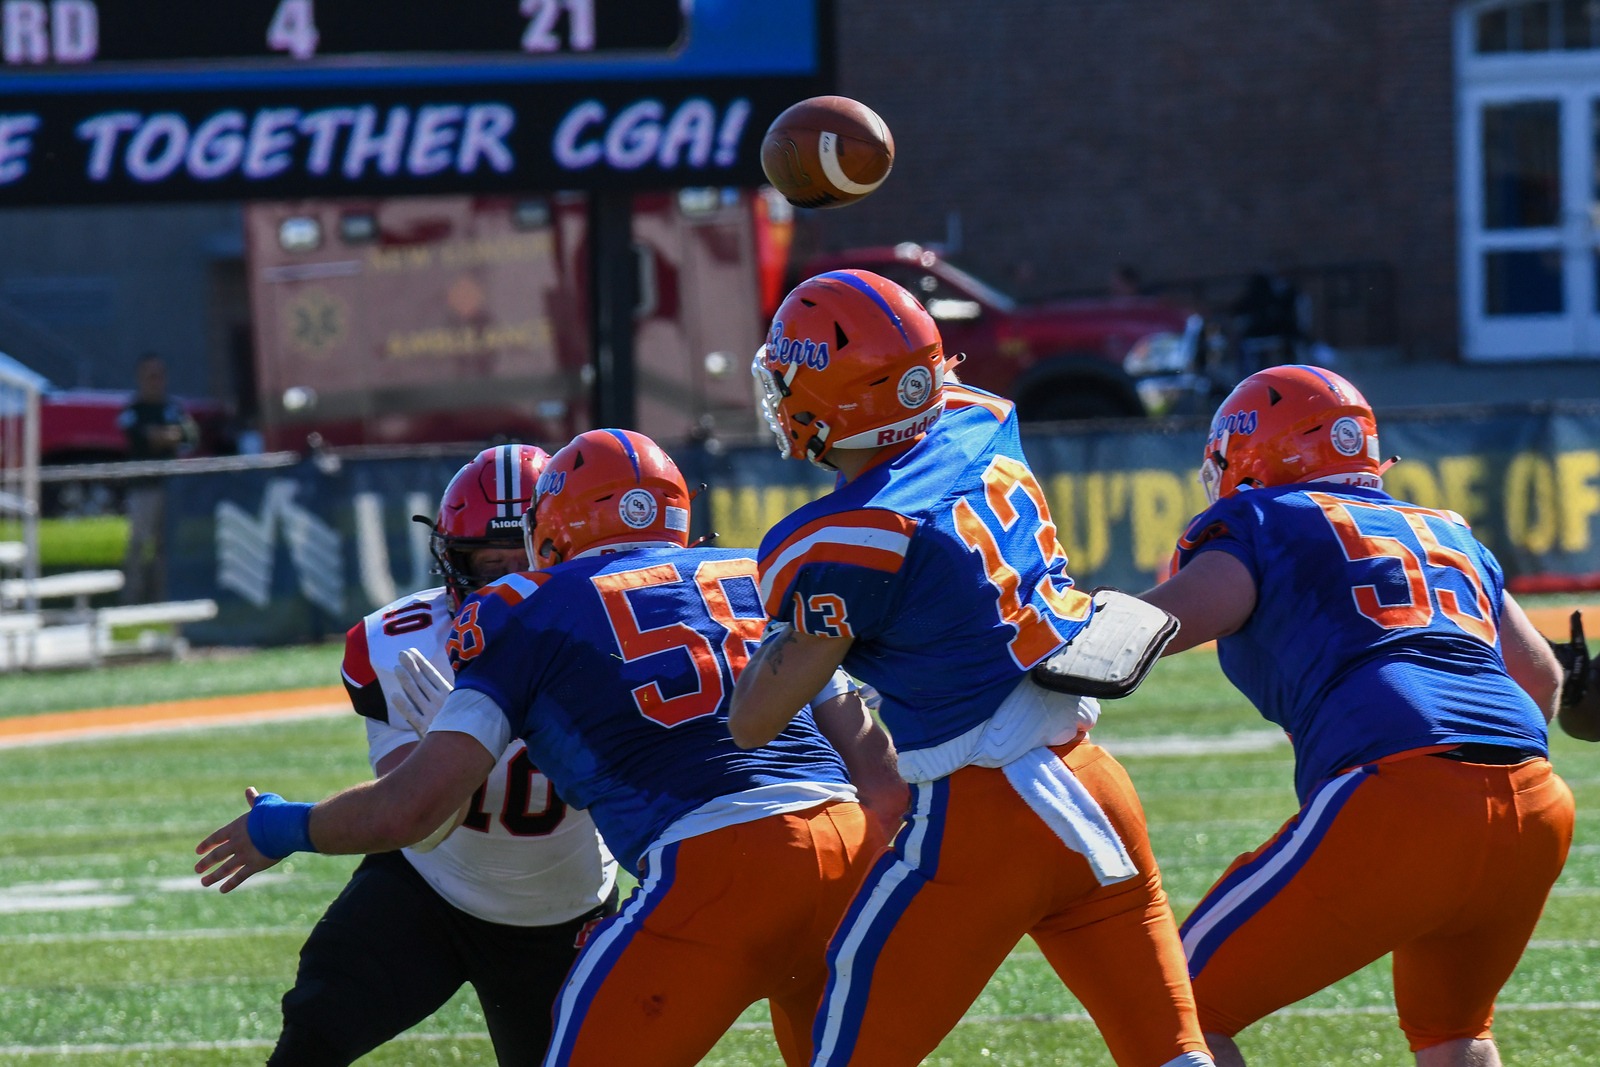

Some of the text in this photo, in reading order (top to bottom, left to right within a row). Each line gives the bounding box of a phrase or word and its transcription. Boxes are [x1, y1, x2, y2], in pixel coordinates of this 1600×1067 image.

[3, 0, 596, 64] RD 4 21
[76, 104, 515, 182] TOGETHER
[552, 98, 751, 169] CGA!
[766, 321, 830, 371] Bears
[877, 405, 943, 446] Riddel
[1208, 410, 1259, 444] ears
[1505, 450, 1600, 555] OF
[952, 454, 1095, 671] 13
[1304, 491, 1499, 649] 55
[382, 602, 433, 637] 10
[590, 558, 769, 729] 58
[793, 591, 856, 638] 13
